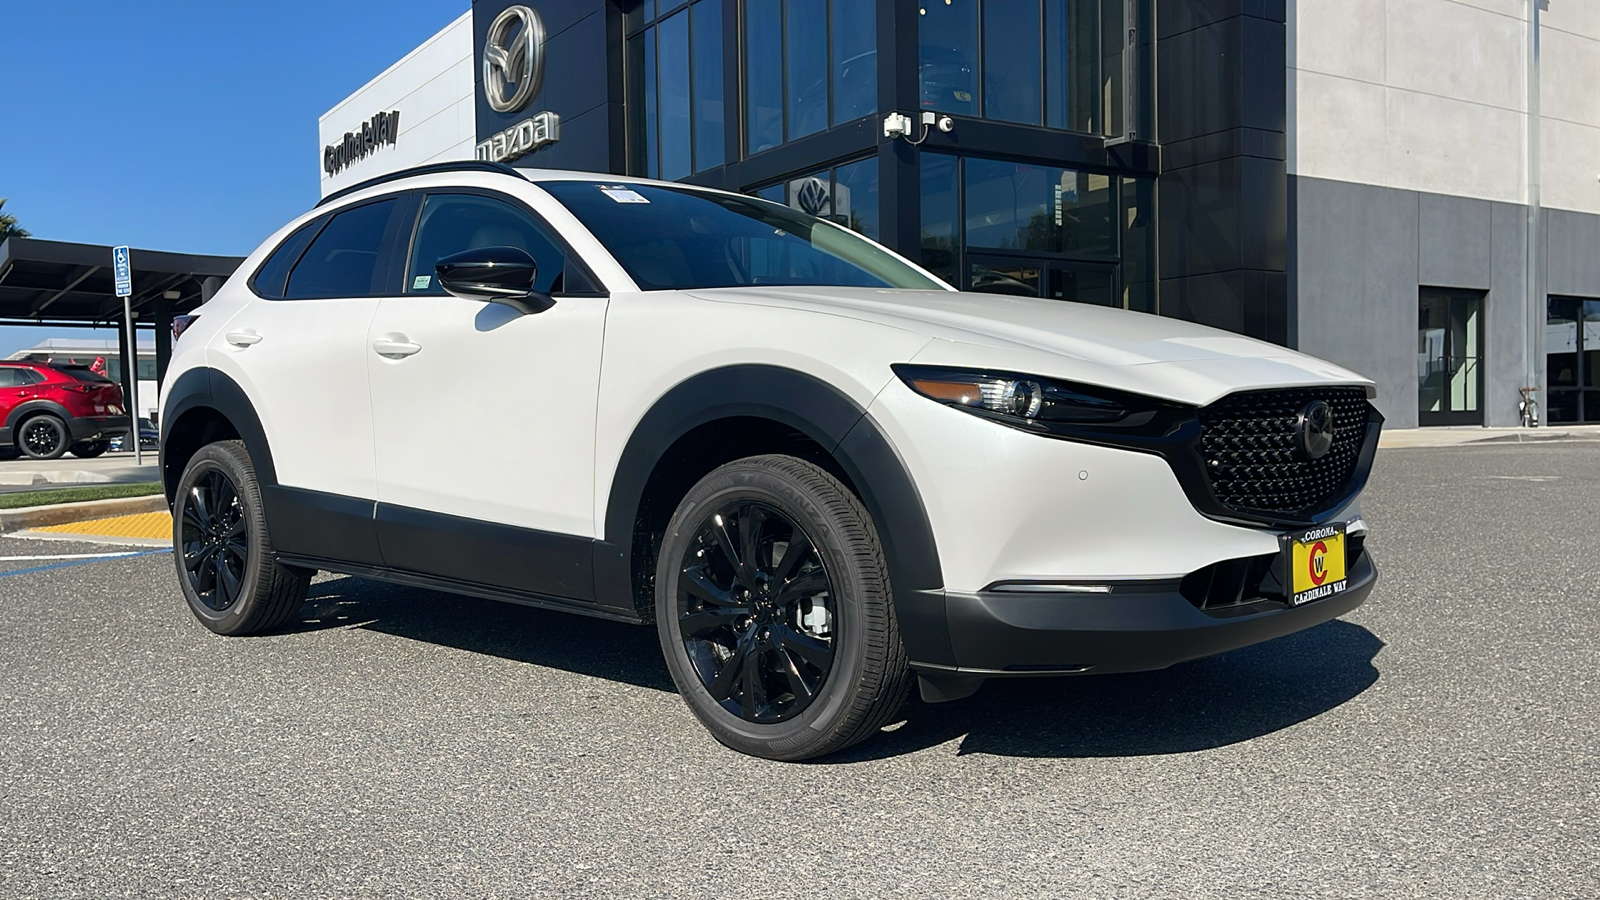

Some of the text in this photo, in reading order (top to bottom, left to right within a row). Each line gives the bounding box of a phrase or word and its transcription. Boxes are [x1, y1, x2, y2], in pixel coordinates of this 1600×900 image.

[741, 473, 831, 539] TANZA
[1305, 527, 1334, 541] CORONA
[1309, 541, 1328, 586] C
[1314, 556, 1324, 574] W
[1294, 580, 1347, 605] CARDINALE WAY
